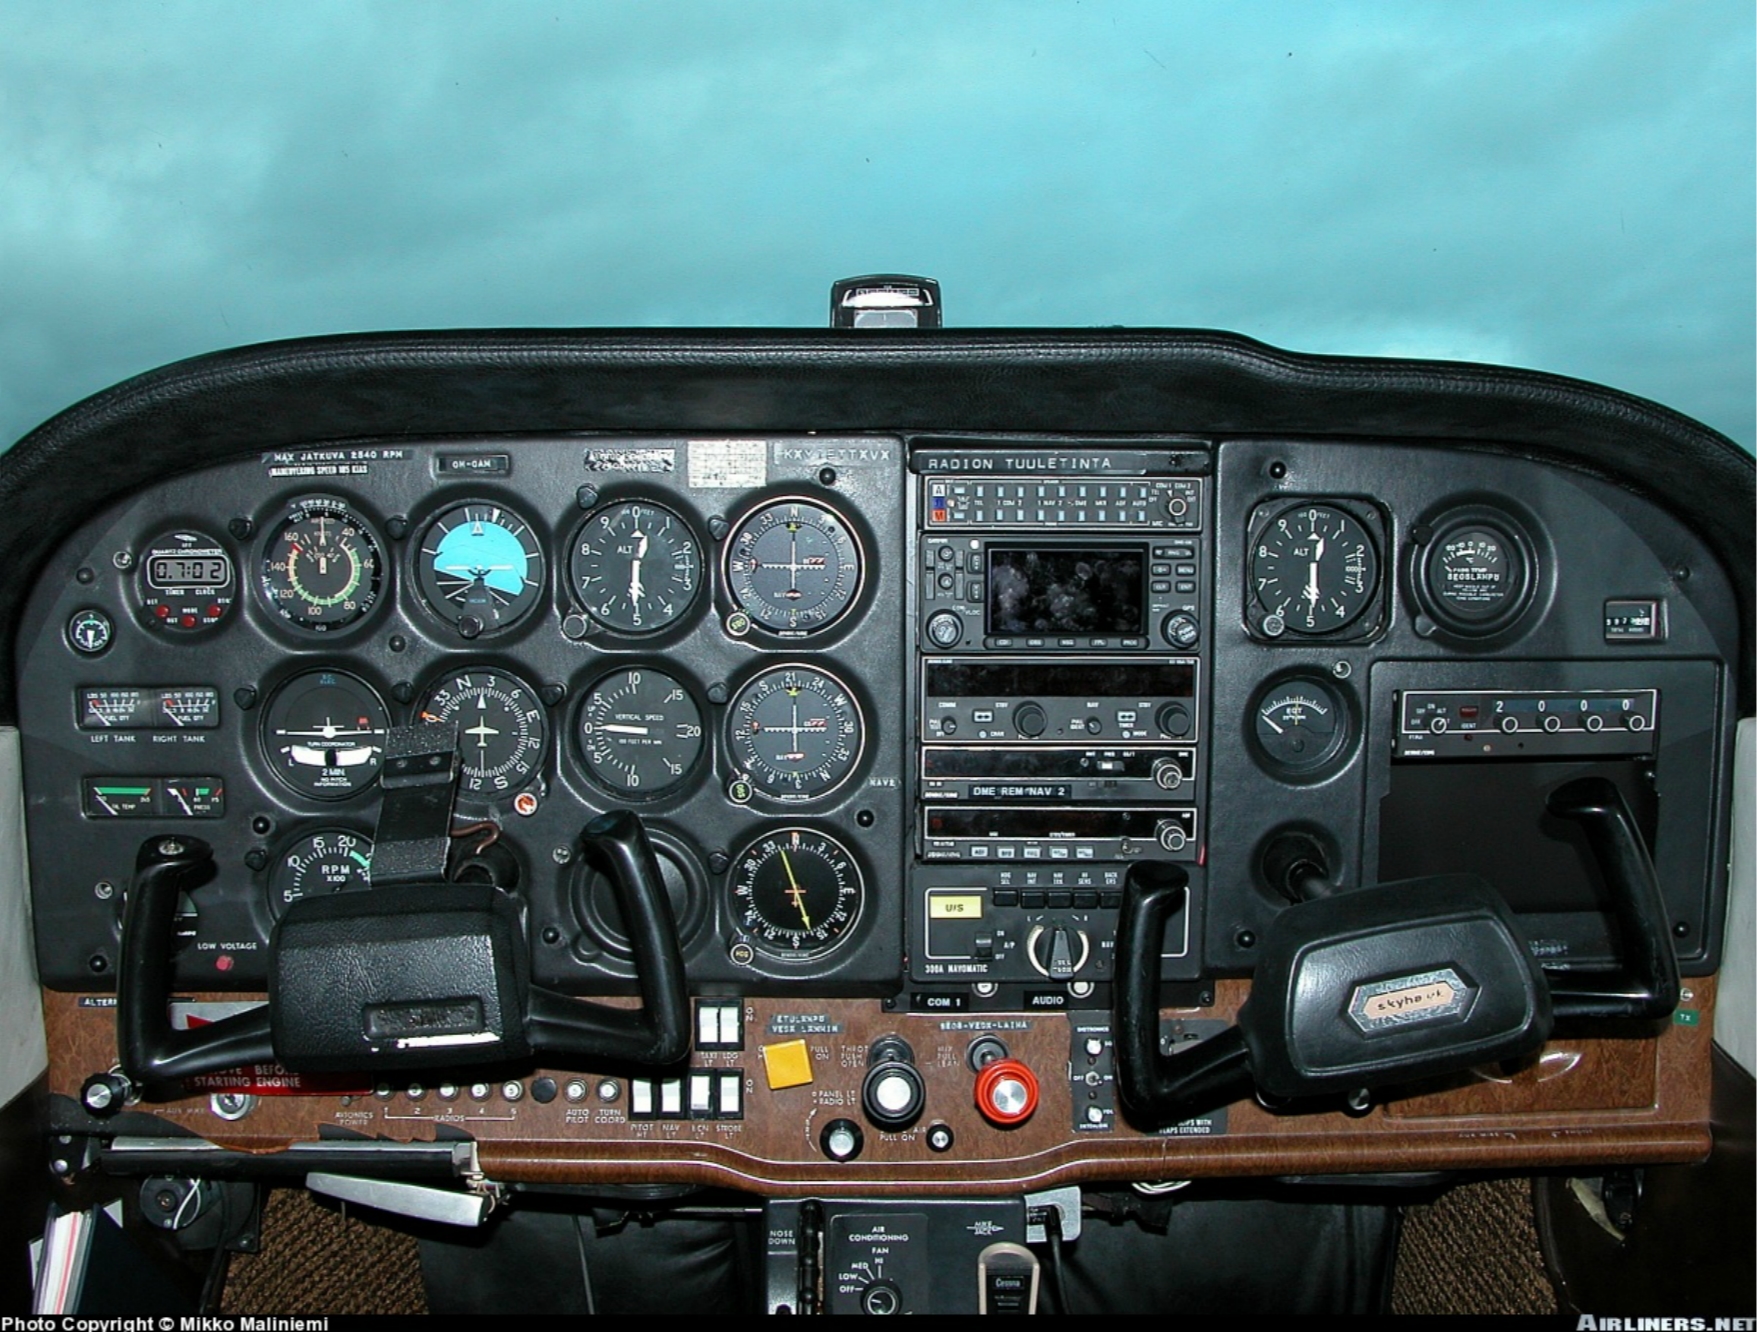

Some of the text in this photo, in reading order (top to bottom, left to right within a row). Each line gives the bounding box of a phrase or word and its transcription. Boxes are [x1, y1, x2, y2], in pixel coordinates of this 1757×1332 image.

[383, 450, 403, 459] RPM
[929, 458, 1112, 469] RADION TUULETINTA
[632, 506, 640, 518] 0
[791, 507, 798, 517] N
[1309, 509, 1317, 521] 0
[600, 517, 609, 529] 9
[1278, 519, 1287, 532] 9
[284, 532, 299, 541] 160
[341, 528, 355, 537] 40
[581, 543, 590, 556] 8
[617, 545, 633, 554] ALT
[683, 541, 691, 554] 2
[1259, 545, 1267, 558] 8
[1293, 548, 1309, 556] ALT
[1356, 544, 1365, 557] 2
[270, 563, 286, 572] 140
[581, 576, 591, 589] 7
[1258, 578, 1267, 590] 7
[280, 589, 294, 598] 120
[343, 601, 356, 610] 80
[601, 603, 610, 616] 6
[663, 603, 673, 616] 4
[1275, 605, 1285, 617] 6
[308, 607, 322, 616] 100
[1335, 605, 1345, 618] 4
[633, 614, 642, 626] 5
[790, 617, 797, 627] S
[1306, 616, 1315, 628] 5
[455, 674, 472, 690] N
[486, 675, 496, 688] 3
[628, 671, 641, 685] 10
[785, 672, 796, 683] 21
[758, 680, 769, 691] S
[434, 689, 451, 706] 33
[510, 688, 522, 699] 6
[593, 692, 602, 705] 5
[671, 689, 684, 701] 15
[833, 693, 849, 707] W
[1496, 700, 1630, 713] 2 0 0 0
[526, 709, 541, 723] E
[584, 722, 593, 734] 0
[686, 726, 701, 737] 20
[91, 735, 137, 743] LEFT TANK
[152, 735, 206, 743] RIGHT TANK
[528, 737, 541, 750] 12
[288, 758, 377, 767] L R
[593, 752, 602, 764] 5
[322, 768, 328, 776] 2
[515, 760, 531, 775] 15
[670, 763, 682, 775] 15
[469, 778, 482, 790] 21
[493, 775, 509, 790] S
[627, 775, 640, 787] 10
[973, 787, 1065, 796] DME REM NAV 2
[313, 836, 326, 849] 15
[337, 835, 357, 847] 20
[287, 855, 301, 867] 10
[321, 864, 350, 875] RPM
[283, 889, 293, 903] 5
[945, 904, 964, 913] U/S
[220, 942, 258, 950] VOLTAGE
[925, 964, 944, 974] 300A
[927, 998, 961, 1007] COM 1
[1032, 996, 1065, 1006] AUDIO
[194, 1076, 302, 1088] STARTING ENGINE
[818, 1090, 856, 1098] PANEL LT
[565, 1109, 590, 1117] AUTO
[599, 1109, 622, 1117] TURN
[565, 1116, 589, 1124] PILOT
[594, 1116, 626, 1124] COORD
[662, 1124, 680, 1132] NAV
[1179, 1126, 1211, 1134] EXTENDED
[769, 1230, 794, 1238] NOSE
[848, 1234, 909, 1242] CONDITIONING
[768, 1237, 796, 1245] DOWN
[851, 1262, 869, 1270] MED
[874, 1257, 884, 1265] HI
[995, 1278, 1021, 1288] Cessna
[839, 1285, 855, 1293] OFF
